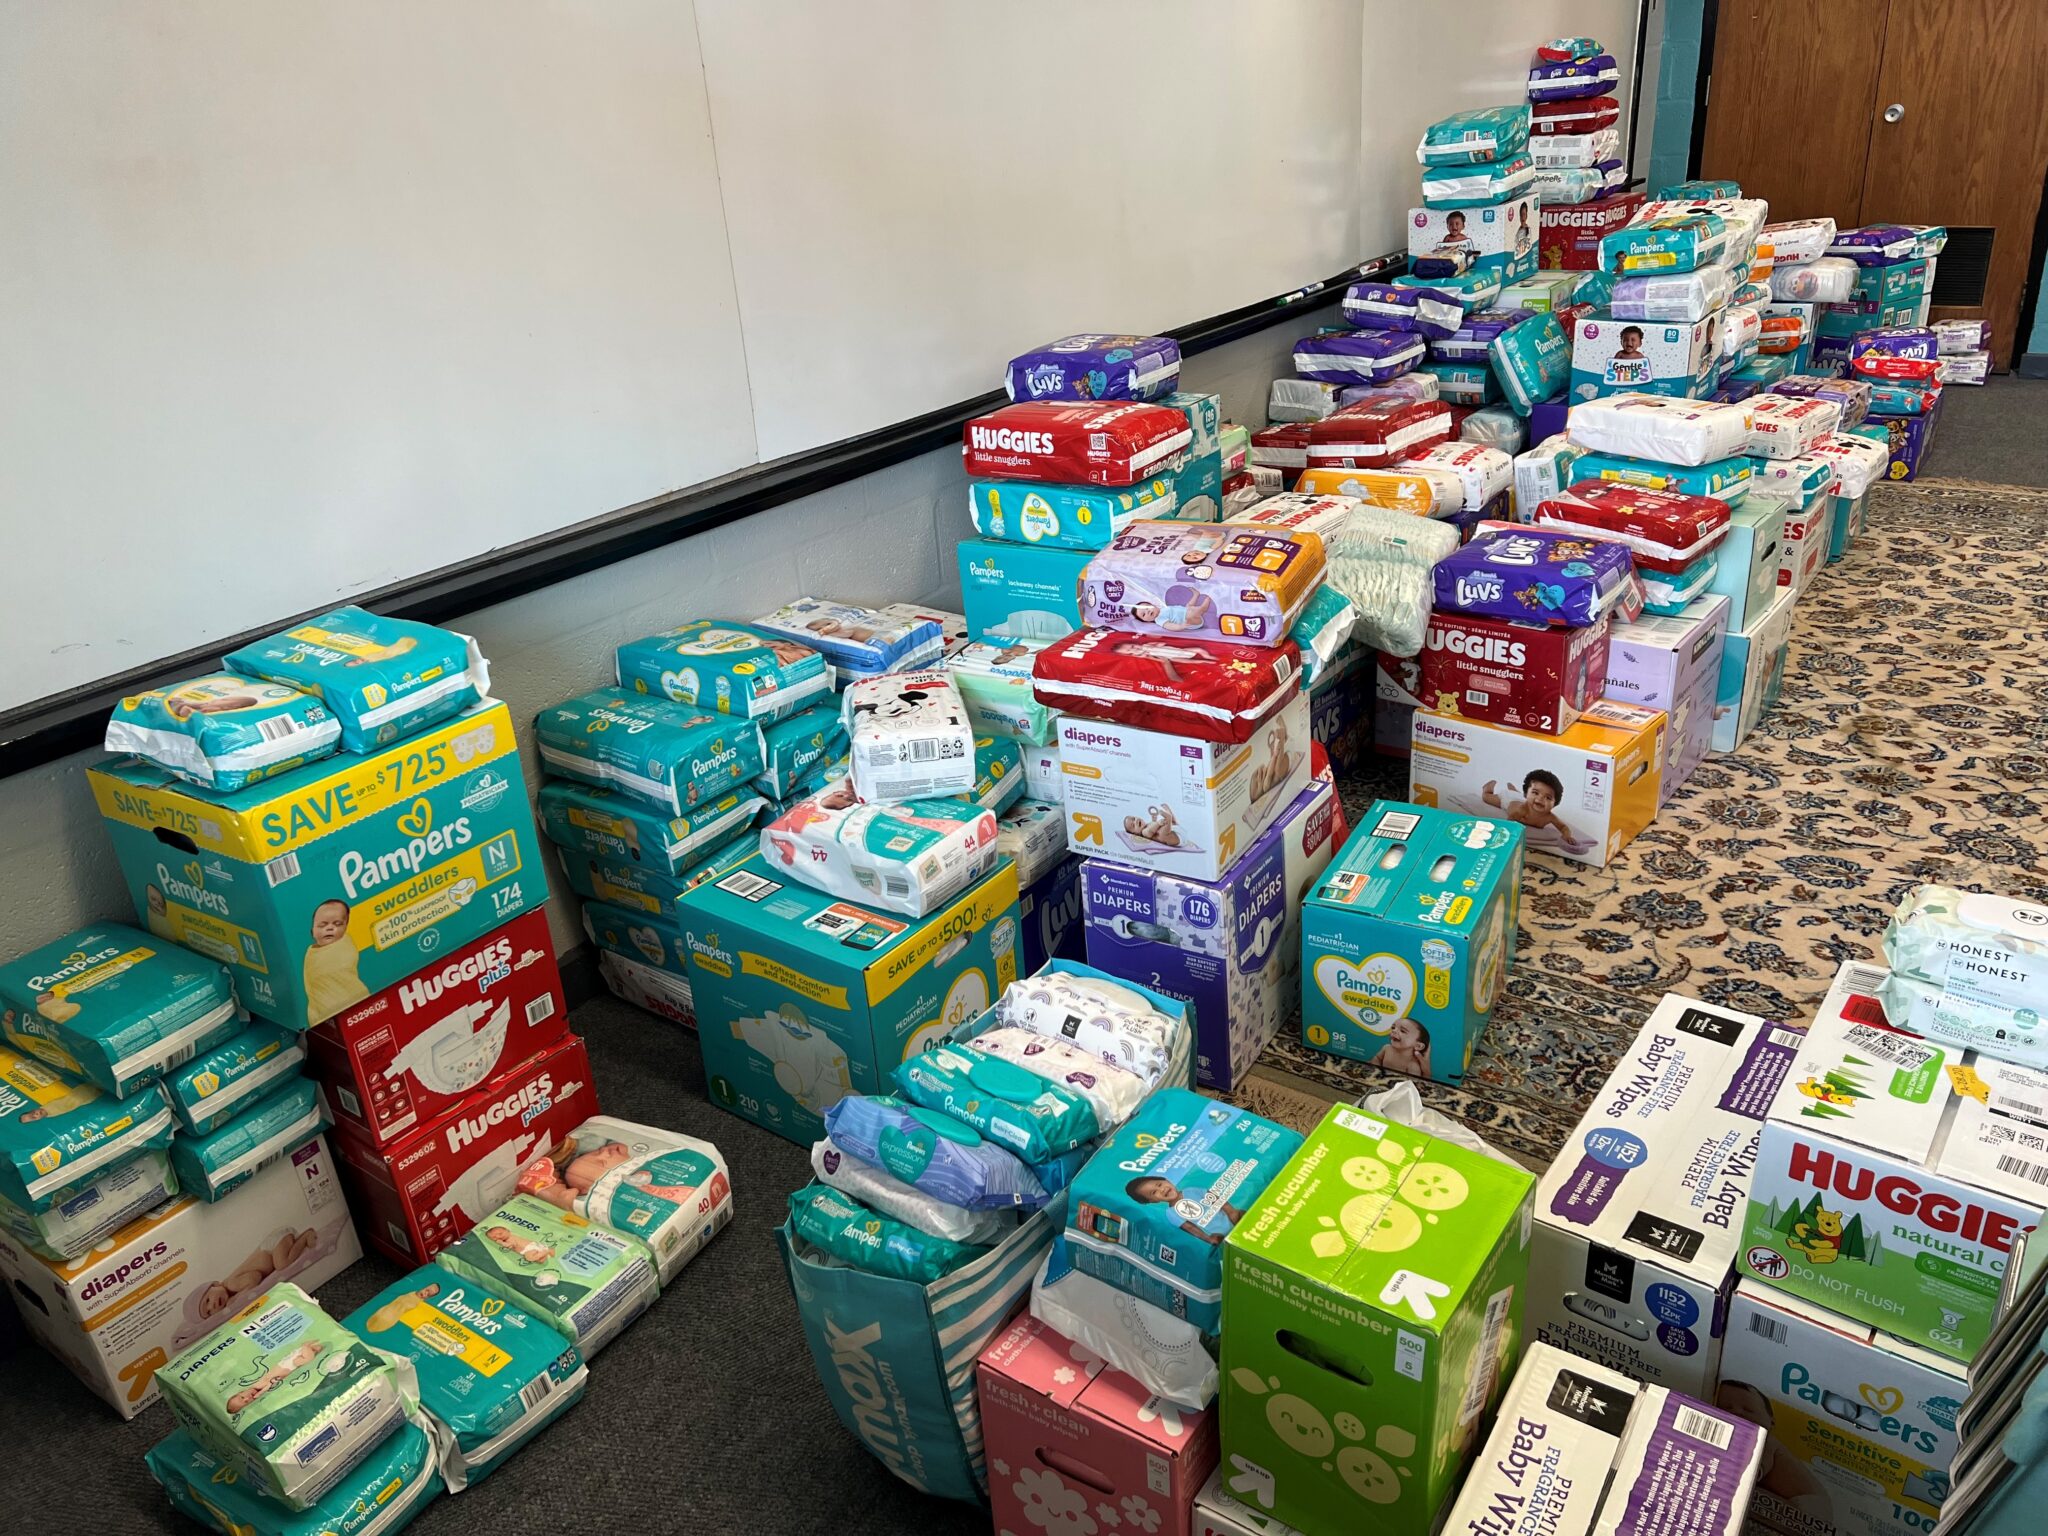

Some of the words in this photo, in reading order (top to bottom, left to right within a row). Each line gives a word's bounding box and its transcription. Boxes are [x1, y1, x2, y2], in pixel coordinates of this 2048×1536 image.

[1540, 211, 1605, 226] HUGGIES
[1630, 242, 1665, 255] Pampers
[1535, 336, 1565, 355] Pampers
[1607, 369, 1650, 382] STEPS
[1612, 362, 1643, 371] Gentle
[971, 426, 1055, 454] HUGGIES
[1770, 446, 1776, 454] 3
[974, 451, 993, 463] little
[993, 454, 1031, 467] snugglers
[1102, 470, 1107, 481] 1
[1606, 482, 1692, 500] HUGGIES
[970, 561, 1005, 579] Pampers
[1098, 601, 1117, 613] Dry
[1118, 604, 1126, 613] &
[1446, 622, 1468, 632] EDITION
[1456, 660, 1478, 673] little
[669, 678, 695, 695] Pampers
[1508, 707, 1518, 716] 72
[1540, 714, 1552, 730] 2
[1064, 728, 1122, 748] diapers
[1415, 720, 1466, 742] diapers
[692, 746, 737, 778] Pampers
[1188, 764, 1196, 776] 1
[1590, 775, 1600, 787] 2
[113, 790, 155, 822] SAVE
[462, 782, 508, 808] PEDIATRICIAN
[262, 782, 359, 848] SAVE
[356, 786, 367, 797] UP
[366, 783, 377, 794] TO
[692, 806, 720, 826] Pampers
[487, 840, 507, 865] N
[964, 834, 975, 849] 44
[339, 817, 473, 899] Pampers
[157, 863, 230, 916] Pampers
[374, 865, 460, 916] swaddlers
[491, 882, 523, 909] 174
[1107, 885, 1135, 897] PREMIUM
[496, 899, 524, 918] DIAPERS
[1093, 891, 1151, 915] DIAPERS
[1189, 899, 1210, 917] 176
[1239, 873, 1283, 930] DIAPERS
[1418, 890, 1456, 924] Pampers
[379, 929, 400, 945] skin
[401, 903, 450, 935] protection
[1189, 914, 1212, 925] DIAPERS
[686, 931, 734, 965] Pampers
[1308, 933, 1360, 952] PEDIATRICIAN
[1334, 932, 1343, 941] #1
[888, 951, 916, 980] SAVE
[917, 944, 929, 958] UP
[928, 937, 939, 950] TO
[1950, 942, 2013, 963] HONEST
[27, 946, 120, 992] Pampers
[399, 938, 513, 1014] HUGGIES
[479, 963, 511, 993] plus
[754, 958, 769, 969] our
[770, 961, 798, 980] softest
[798, 974, 831, 995] comfort
[1151, 972, 1162, 987] 2
[1966, 961, 2029, 983] HONEST
[763, 967, 779, 980] and
[779, 973, 823, 1000] protection
[1156, 987, 1172, 998] PER
[1173, 991, 1195, 1003] PACK
[1337, 969, 1401, 1001] Pampers
[895, 995, 939, 1032] PEDIATRICIAN
[1343, 993, 1396, 1012] swaddlers
[1332, 1032, 1347, 1043] 96
[1102, 1050, 1117, 1063] 96
[1638, 1034, 1676, 1068] Baby
[224, 1056, 258, 1078] Pampers
[1652, 1050, 1686, 1099] FRAGRANCE
[1606, 1071, 1658, 1118] Wipes
[1658, 1066, 1694, 1112] PREMIUM
[446, 1074, 554, 1153] HUGGIES
[522, 1096, 551, 1127] plus
[739, 1094, 760, 1113] 210
[944, 1095, 986, 1128] Pampers
[1637, 1098, 1661, 1118] FREE
[1236, 1119, 1252, 1132] 216
[1341, 1112, 1357, 1127] 500
[67, 1131, 106, 1154] Pampers
[994, 1121, 1027, 1144] Baby-Clean
[907, 1140, 926, 1156] Pampers
[1119, 1122, 1188, 1173] Pampers
[1616, 1142, 1641, 1164] 1152
[305, 1164, 320, 1180] N
[1681, 1138, 1719, 1190] PREMIUM
[1691, 1150, 1725, 1208] FRAGRANCE
[1718, 1130, 1741, 1156] FREE
[1243, 1205, 1279, 1242] fresh
[1277, 1142, 1331, 1207] cucumber
[1577, 1170, 1594, 1194] sensitive
[1592, 1175, 1610, 1198] Suitable
[697, 1197, 711, 1214] 40
[1567, 1190, 1579, 1206] skin
[1586, 1195, 1598, 1206] for
[1703, 1180, 1746, 1229] Baby
[1788, 1141, 2040, 1254] HUGGIE
[496, 1210, 541, 1234] DIAPERS
[1262, 1214, 1293, 1249] cloth-like
[1289, 1194, 1307, 1221] baby
[1301, 1179, 1321, 1202] wipes
[1891, 1224, 1984, 1267] natural
[80, 1241, 169, 1301] diapers
[86, 1298, 103, 1312] with
[151, 1246, 186, 1272] channels
[1233, 1255, 1286, 1291] fresh
[1289, 1278, 1393, 1337] cucumber
[1233, 1271, 1283, 1301] cloth-like
[1282, 1292, 1309, 1317] baby
[1309, 1305, 1342, 1328] wipes
[1658, 1286, 1687, 1307] 1152
[1792, 1264, 1815, 1283] DO
[1818, 1273, 1852, 1296] NOT
[1855, 1288, 1906, 1318] FLUSH
[437, 1288, 504, 1337] Pampers
[1660, 1306, 1681, 1321] 12PK
[243, 1324, 256, 1337] N
[432, 1316, 471, 1343] swaddlers
[1568, 1321, 1642, 1360] PREMIUM
[1670, 1326, 1685, 1336] SAVE
[988, 1327, 1027, 1361] fresh
[1399, 1334, 1424, 1353] 500
[1547, 1321, 1626, 1363] FRAGRANCE
[1629, 1357, 1662, 1378] FREE
[1666, 1335, 1686, 1349] $70
[179, 1335, 237, 1383] DIAPERS
[488, 1352, 501, 1366] N
[1404, 1360, 1414, 1372] 5
[131, 1391, 158, 1412] SUPER
[985, 1379, 1029, 1408] fresh
[1043, 1405, 1090, 1437] clean
[1498, 1416, 1548, 1488] Baby
[1804, 1419, 1903, 1470] Sensitive
[1809, 1435, 1860, 1462] CLINICALLY
[1824, 1450, 1875, 1478] SENSITIVE
[344, 1500, 379, 1534] Pampers
